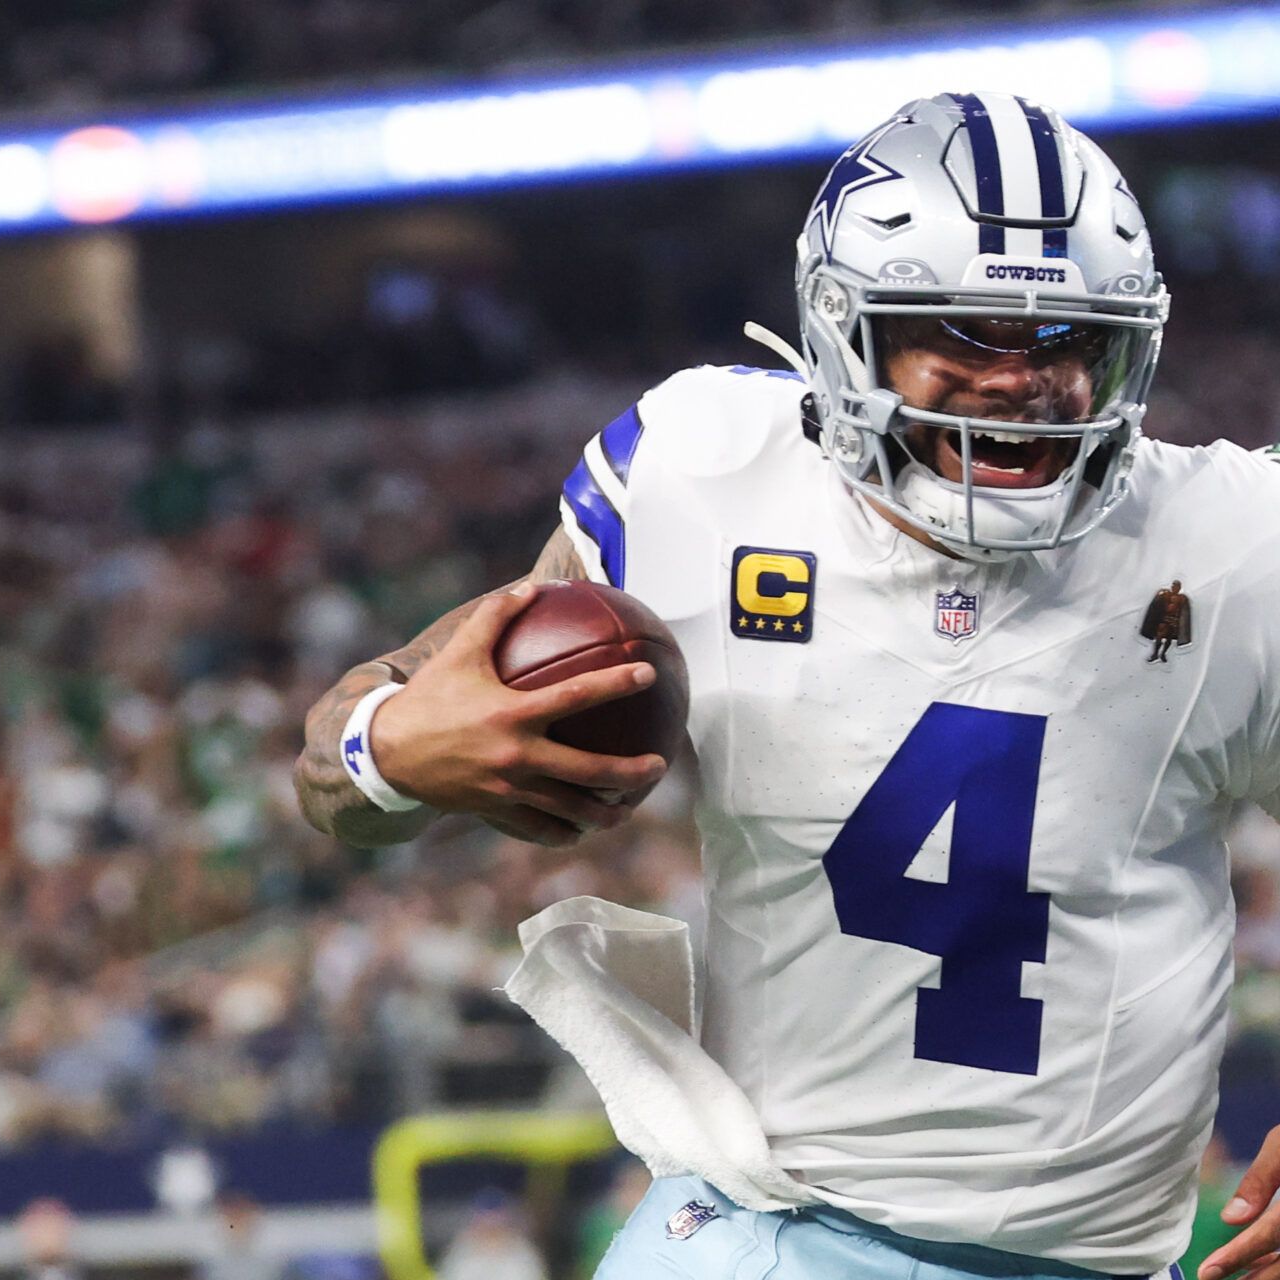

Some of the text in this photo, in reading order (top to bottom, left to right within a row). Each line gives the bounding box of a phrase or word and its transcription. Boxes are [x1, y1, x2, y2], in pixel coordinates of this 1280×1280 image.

[986, 265, 1066, 283] COWBOYS
[736, 553, 810, 617] C
[941, 611, 972, 633] NFL
[822, 701, 1052, 1076] 4
